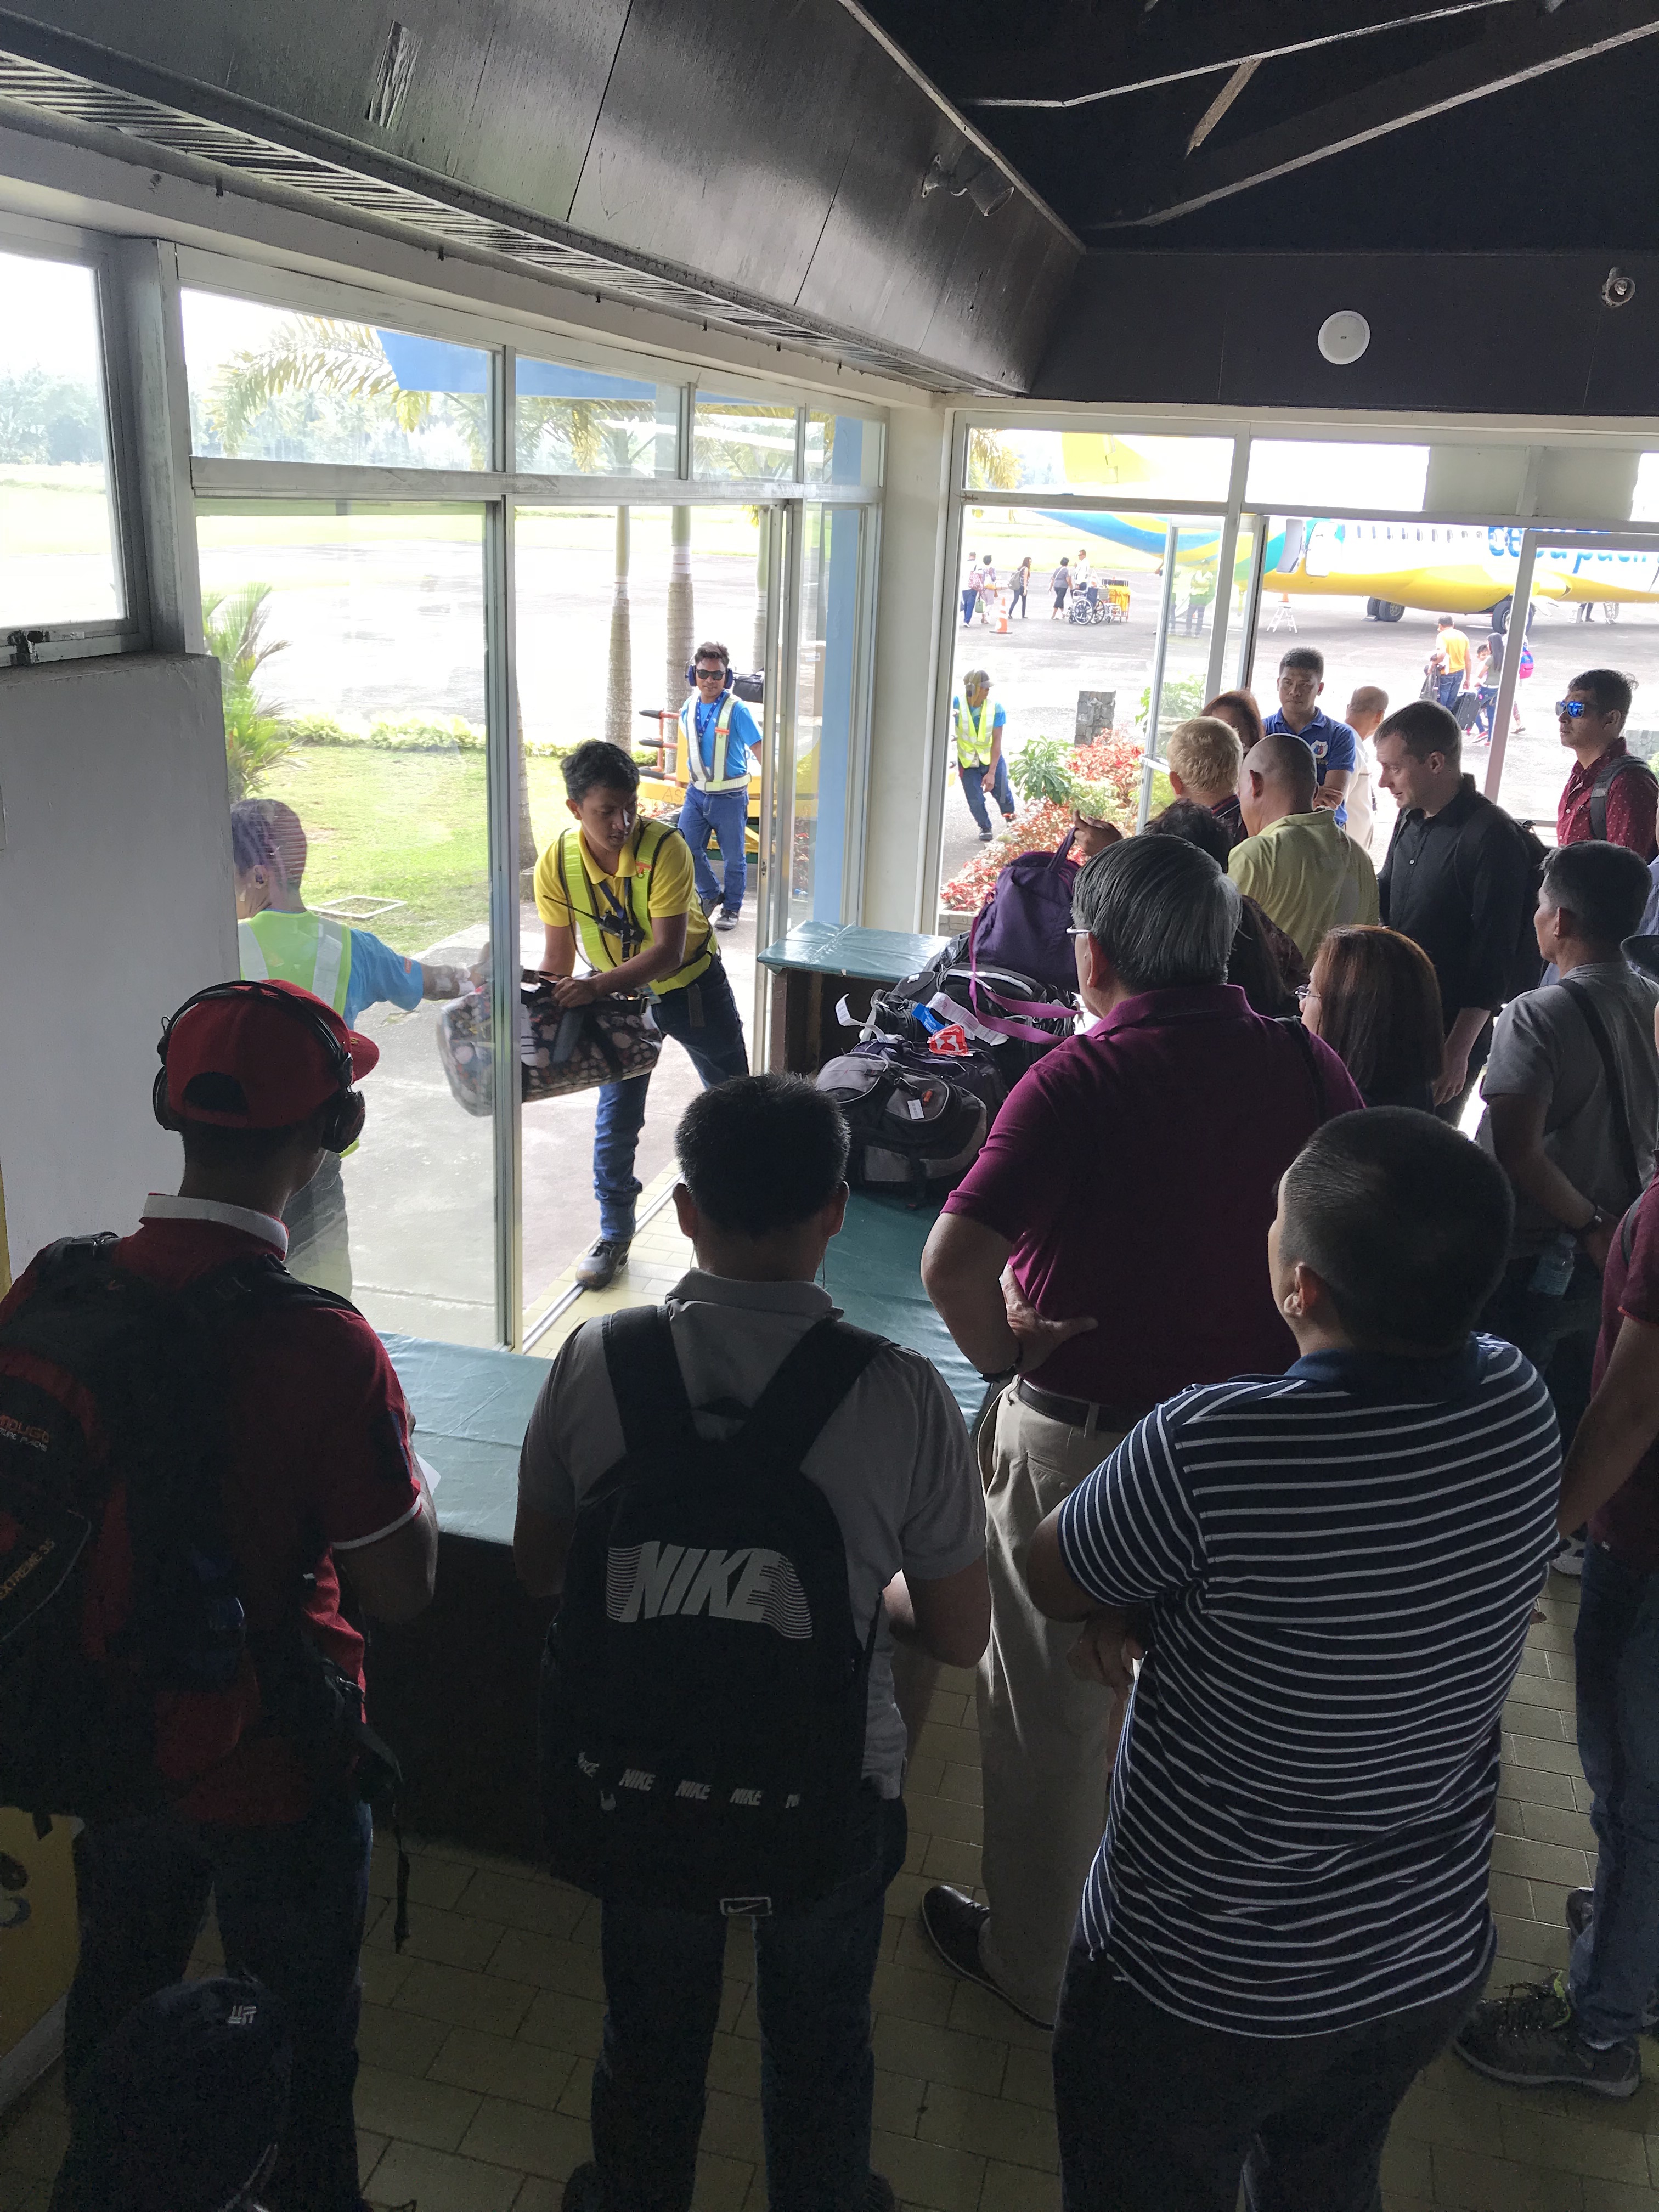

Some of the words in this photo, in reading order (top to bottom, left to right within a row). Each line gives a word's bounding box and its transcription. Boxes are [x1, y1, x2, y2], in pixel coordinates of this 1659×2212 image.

[923, 1019, 938, 1035] Transf
[619, 1541, 790, 1624] NIKE
[618, 1769, 656, 1791] NIKE
[675, 1779, 712, 1800] NIKE
[729, 1788, 762, 1806] NIKE
